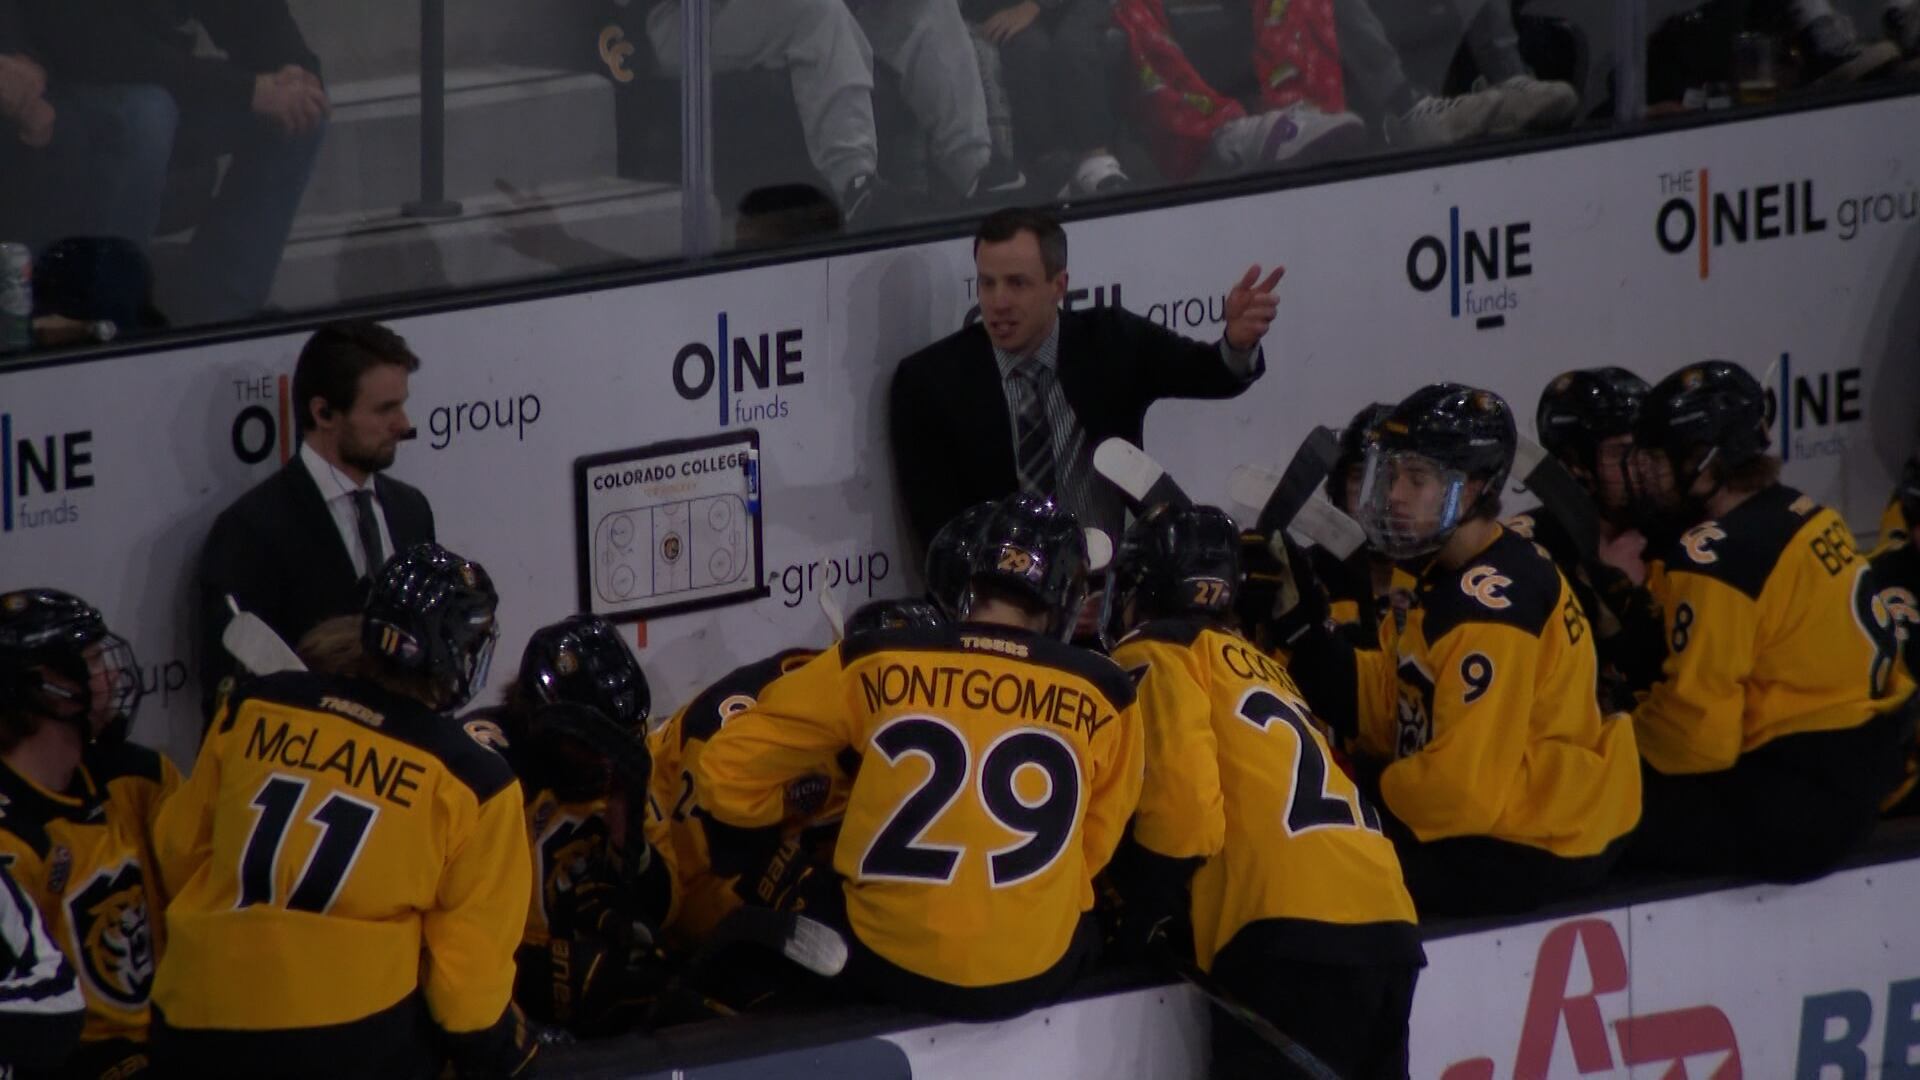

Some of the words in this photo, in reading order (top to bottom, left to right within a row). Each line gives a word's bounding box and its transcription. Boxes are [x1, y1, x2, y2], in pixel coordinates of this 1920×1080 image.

[1657, 170, 1695, 194] THE
[1836, 191, 1919, 241] grou
[1147, 292, 1227, 330] grou
[1465, 288, 1518, 316] funds
[232, 376, 273, 402] THE
[735, 393, 790, 424] funds
[1764, 368, 1862, 430] NE
[429, 393, 542, 450] group
[17, 430, 95, 497] NE
[593, 464, 676, 491] COLORADO
[681, 451, 749, 477] COLLEGE
[18, 501, 80, 529] funds
[1193, 581, 1224, 607] 27
[1671, 602, 1694, 653] 8
[1460, 653, 1494, 704] 9
[244, 716, 426, 810] McLANE
[857, 714, 1080, 888] 29
[235, 771, 381, 915] 11
